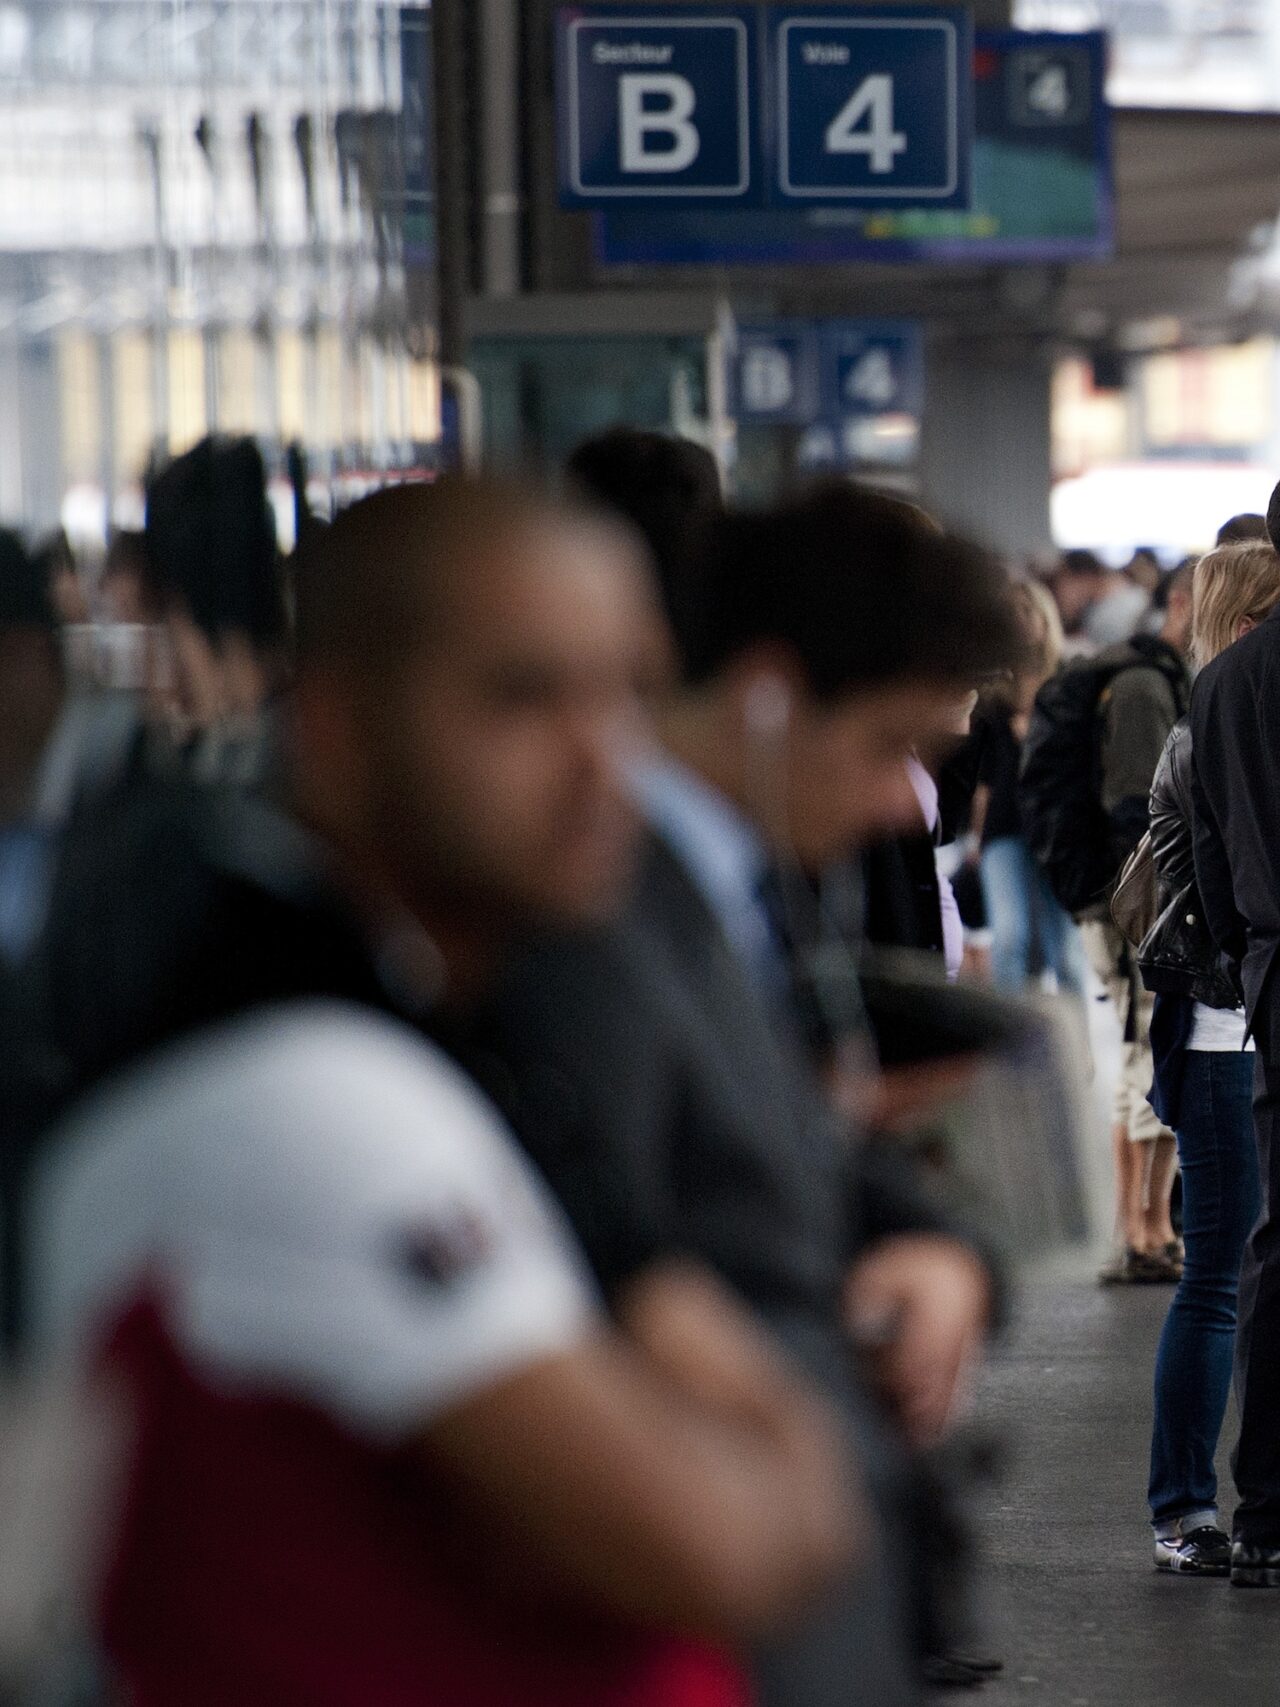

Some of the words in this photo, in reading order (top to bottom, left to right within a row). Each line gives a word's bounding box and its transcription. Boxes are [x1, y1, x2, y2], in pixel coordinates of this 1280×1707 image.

[593, 41, 674, 63] Secteur
[802, 43, 849, 64] Voie
[1029, 65, 1067, 116] 4
[619, 73, 700, 172] B
[826, 73, 907, 174] 4
